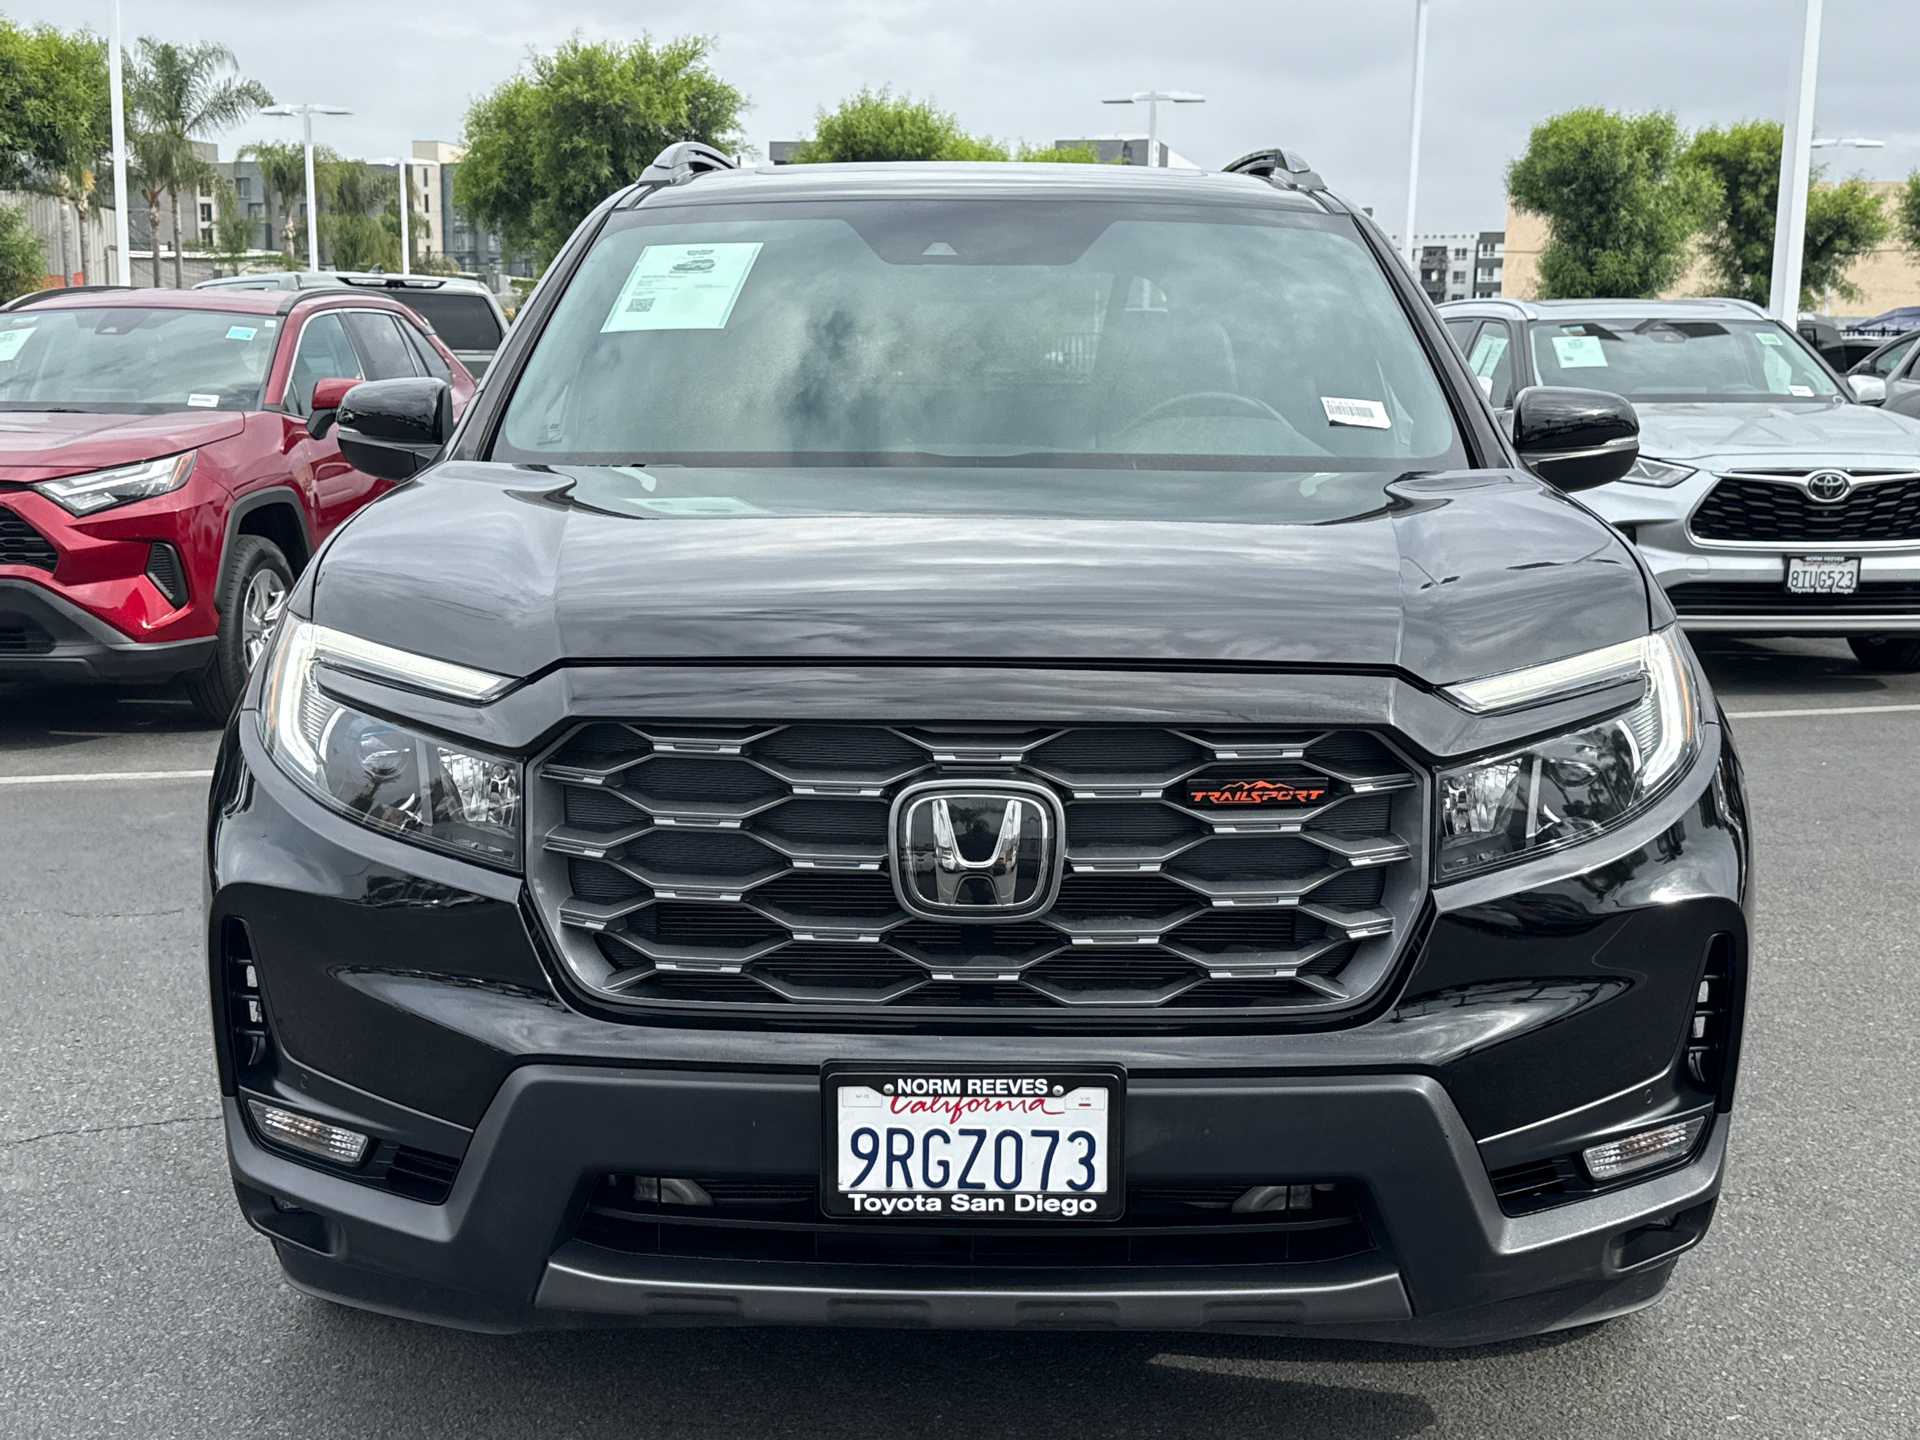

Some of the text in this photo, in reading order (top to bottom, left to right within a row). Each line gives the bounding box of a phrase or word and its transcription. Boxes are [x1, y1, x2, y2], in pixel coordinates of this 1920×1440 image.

[1790, 570, 1854, 588] 8TUG523
[1190, 789, 1325, 804] TRAILSPORT
[897, 1078, 1049, 1095] NORM REEVES
[890, 1096, 1066, 1125] California
[850, 1127, 1097, 1191] 9RGZ073
[848, 1193, 1098, 1216] Toyota San Diego
